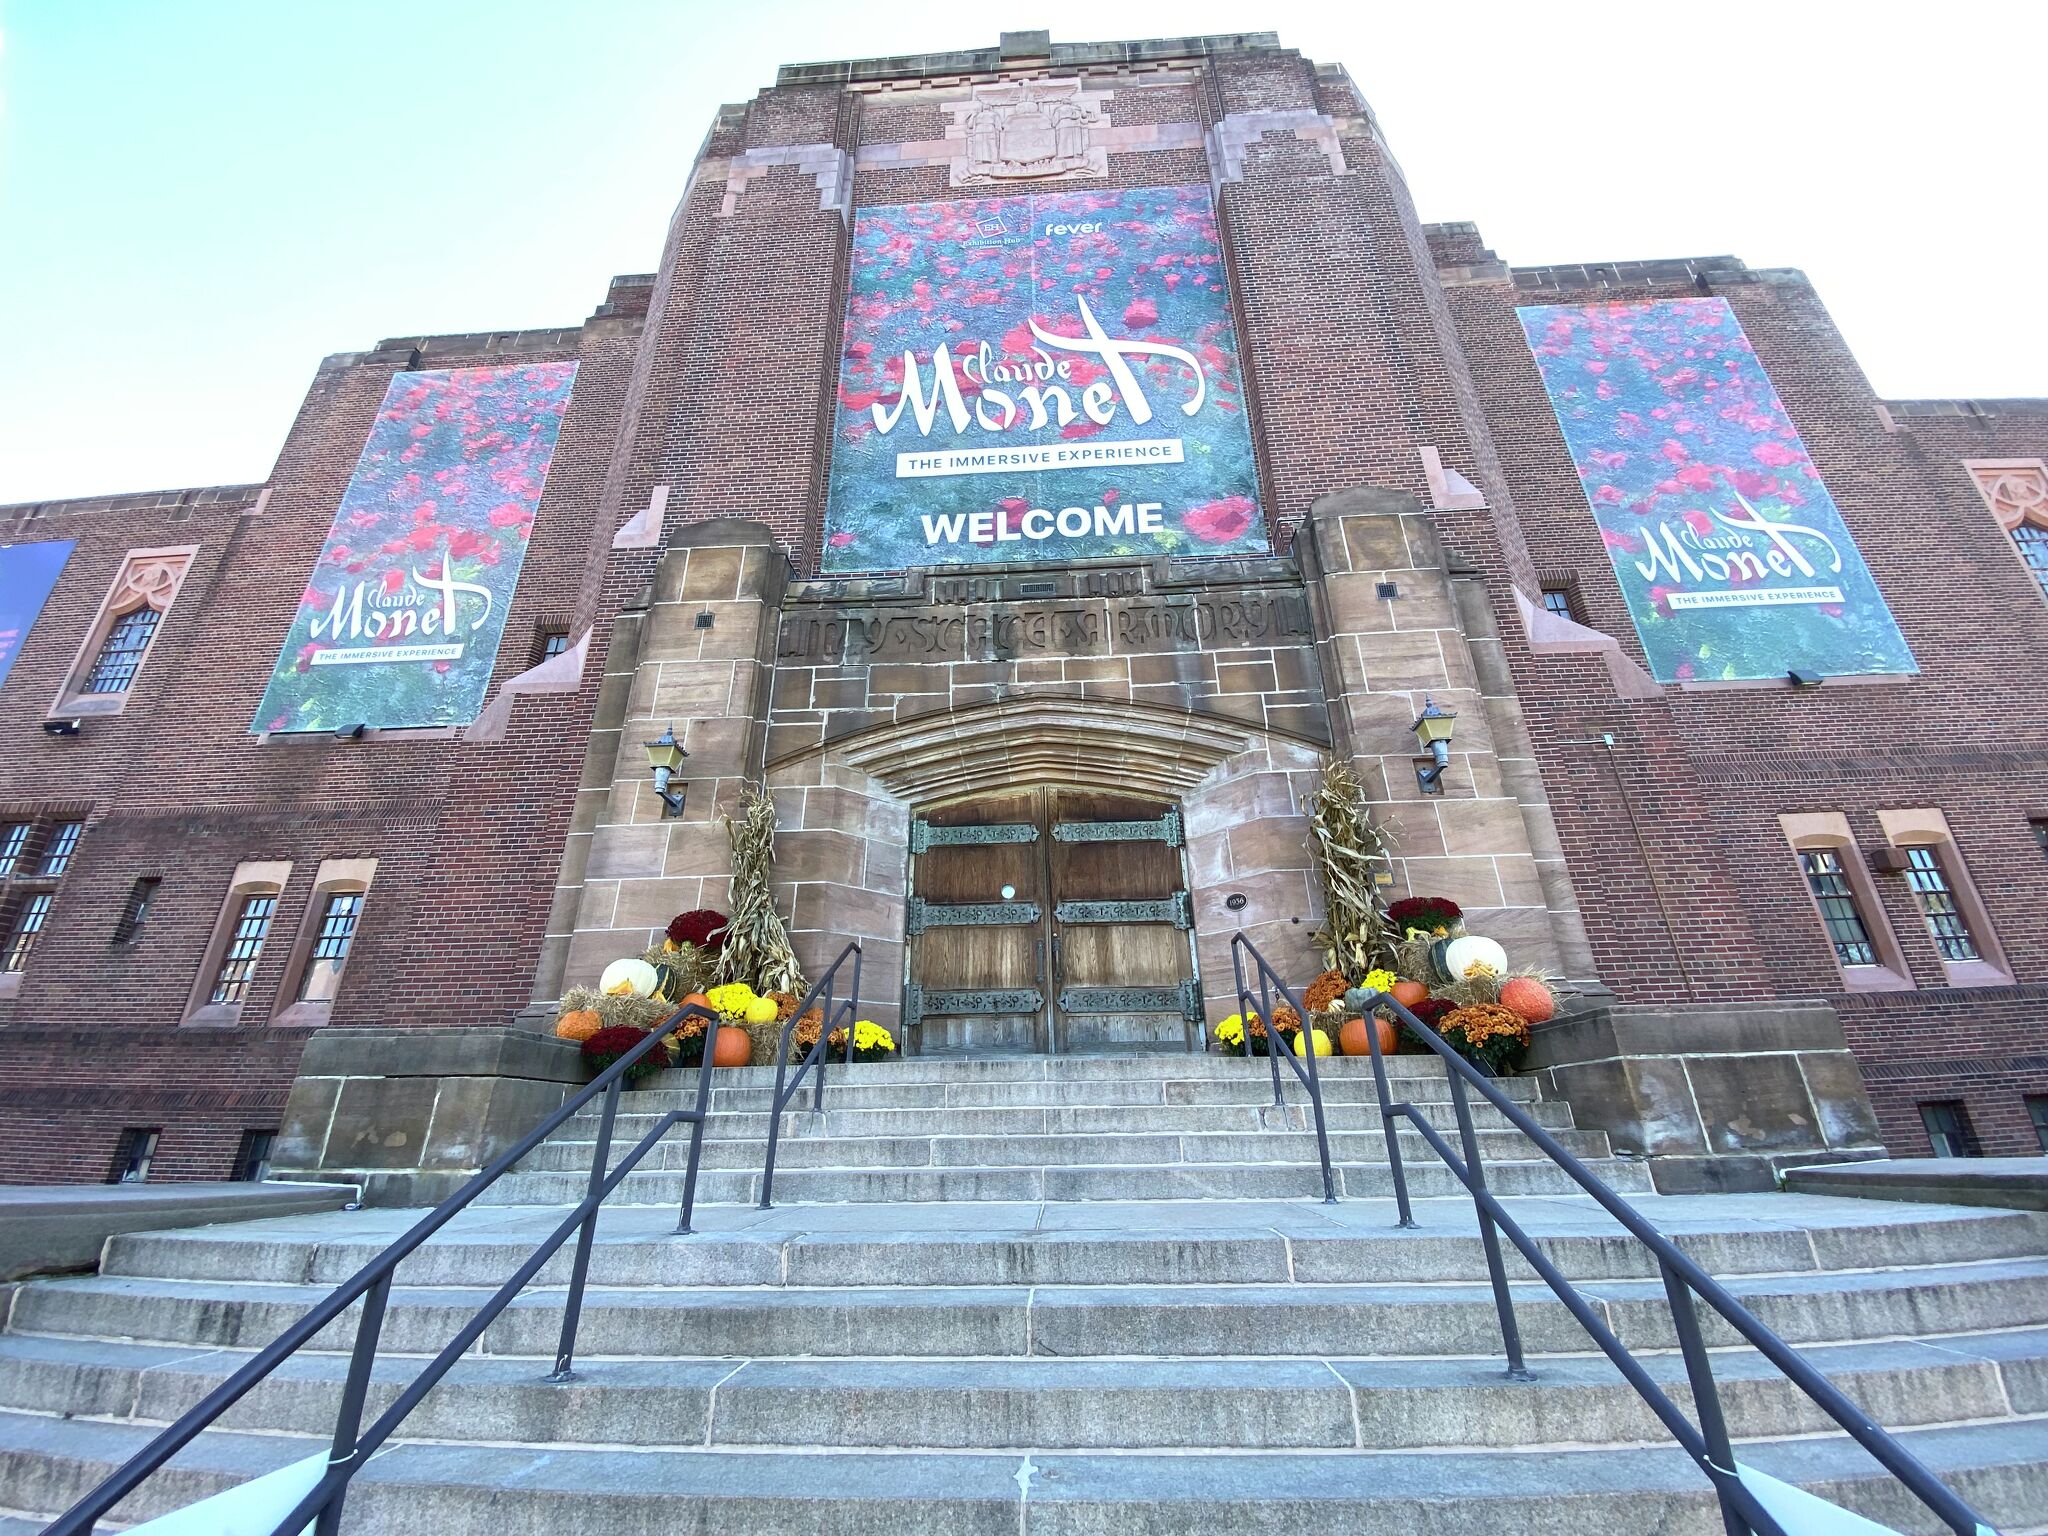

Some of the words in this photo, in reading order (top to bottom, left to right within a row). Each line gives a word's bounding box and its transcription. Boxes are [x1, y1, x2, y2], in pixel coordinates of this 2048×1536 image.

[1045, 222, 1103, 236] fever
[963, 239, 1002, 247] Exhibition
[1004, 237, 1021, 245] Hub
[962, 339, 1072, 383] Claude
[908, 458, 943, 470] THE
[949, 452, 1051, 468] IMMERSIVE
[1058, 446, 1172, 461] EXPERIENCE
[920, 502, 1164, 545] WELCOME
[1680, 520, 1754, 550] Claude
[367, 580, 425, 609] Claude
[1675, 596, 1698, 605] THE
[1701, 593, 1766, 604] IMMERSIVE
[1768, 590, 1837, 601] EXPERIENCE
[319, 653, 337, 661] THE
[340, 650, 394, 660] IMMERSIVE
[397, 647, 457, 658] EXPERIENCE
